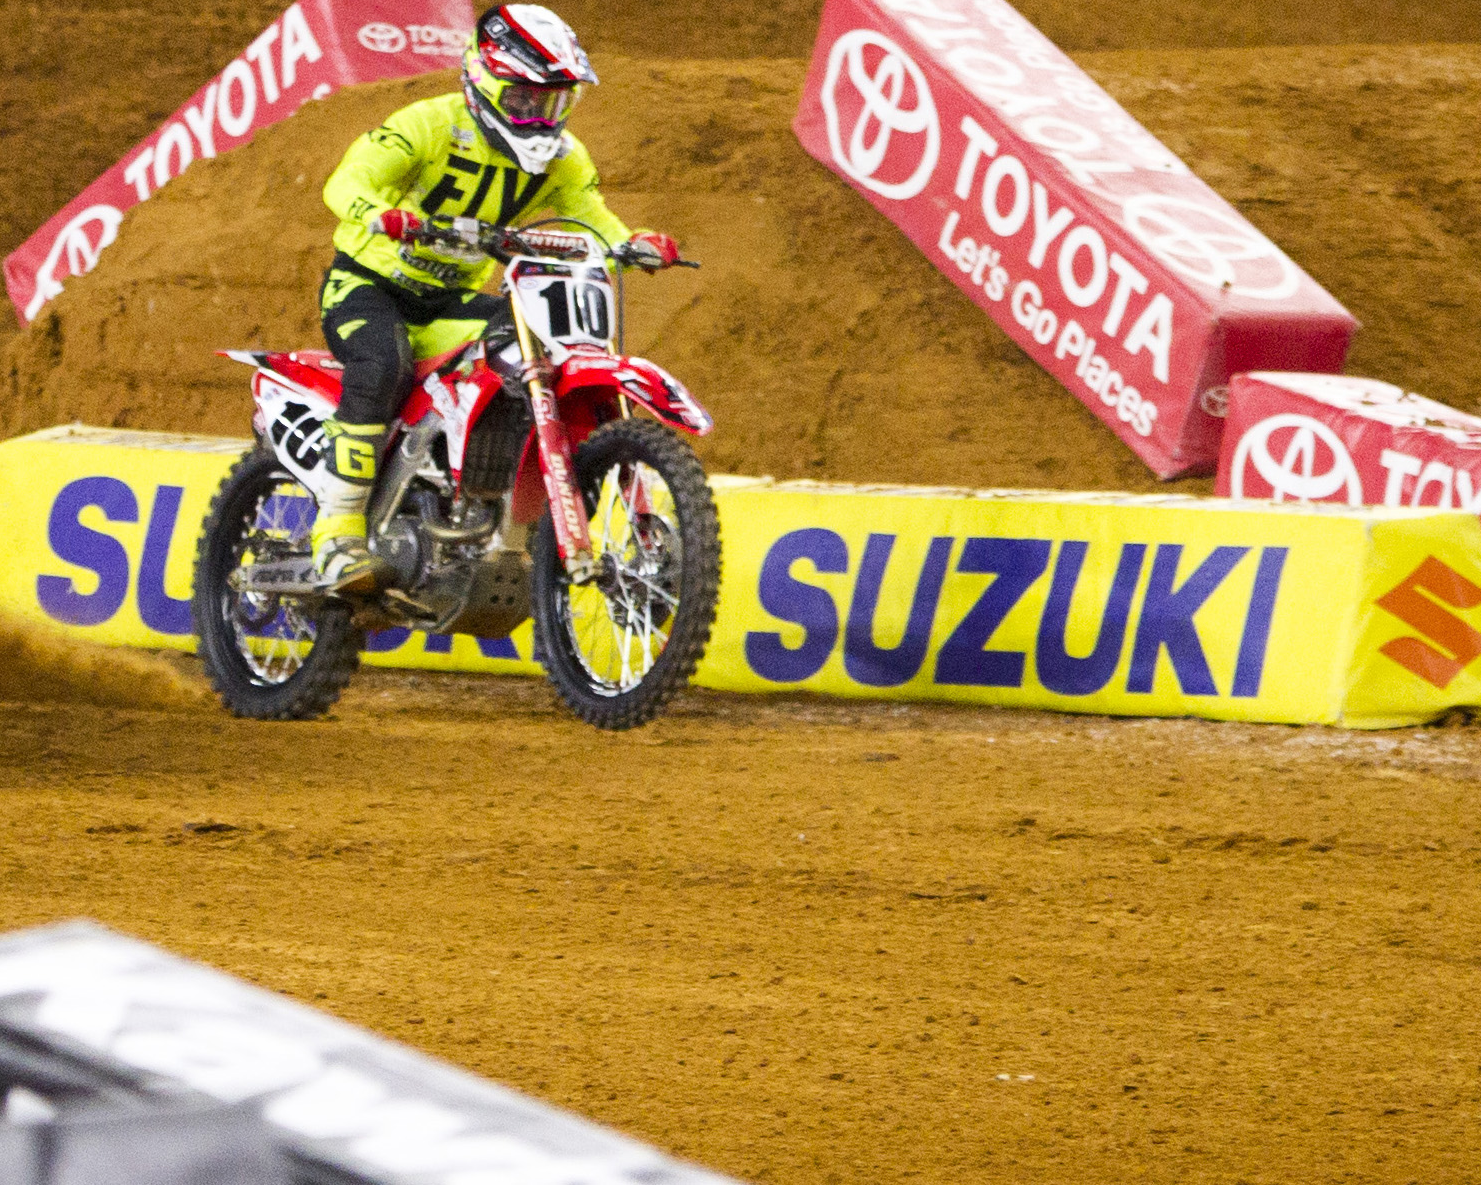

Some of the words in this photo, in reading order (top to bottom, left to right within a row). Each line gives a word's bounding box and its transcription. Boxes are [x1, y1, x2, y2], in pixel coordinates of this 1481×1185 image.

[123, 4, 322, 202] TOYOTA
[539, 281, 608, 339] 10
[938, 212, 1009, 303] Let's
[1011, 280, 1058, 346] Go
[1056, 320, 1157, 438] Places
[954, 117, 1174, 382] TOYOTA
[550, 452, 582, 540] DUNLOP
[745, 528, 1288, 699] SUZUKI
